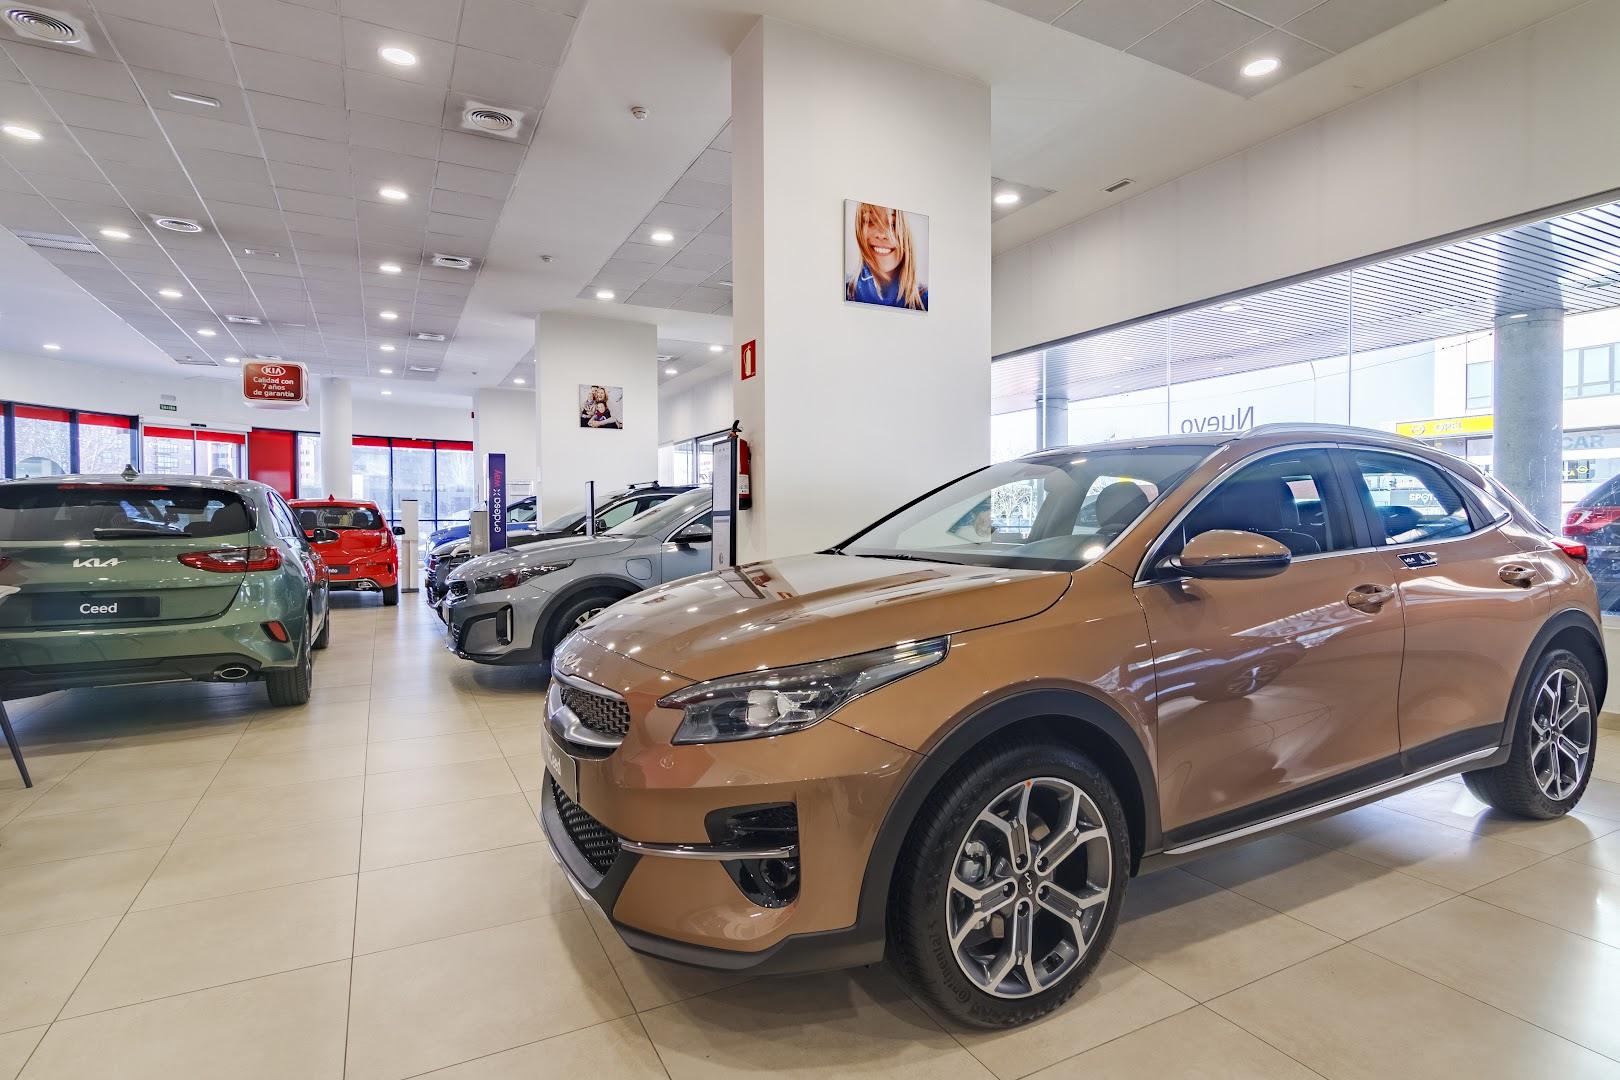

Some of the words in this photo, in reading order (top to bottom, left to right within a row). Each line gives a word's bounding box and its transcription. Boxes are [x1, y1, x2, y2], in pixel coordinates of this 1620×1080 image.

[253, 376, 279, 384] Calidad
[492, 497, 501, 533] endesa
[80, 603, 118, 614] Ceed
